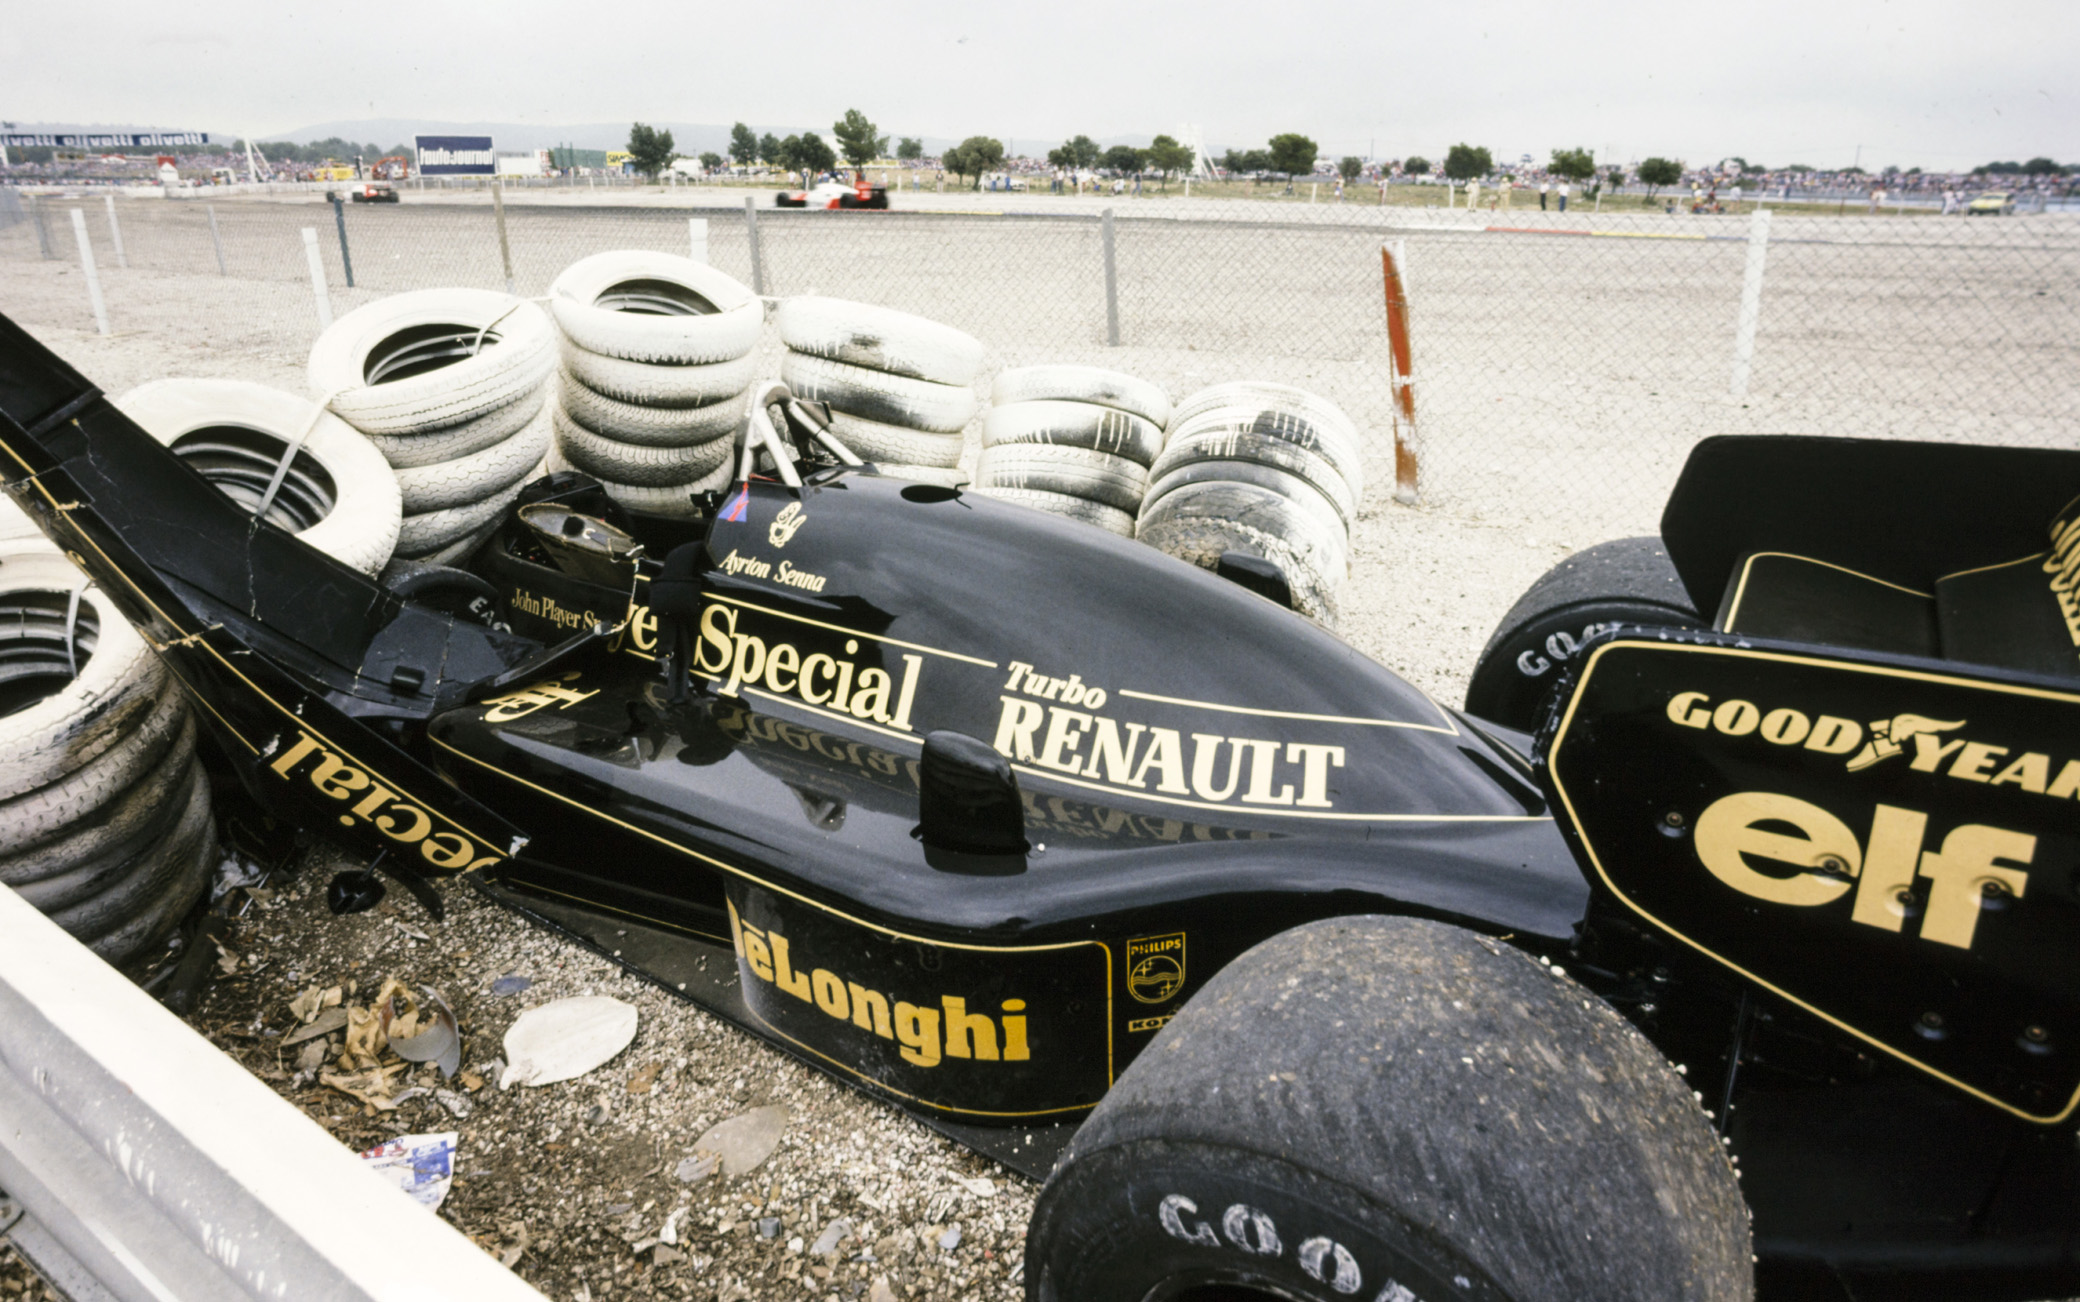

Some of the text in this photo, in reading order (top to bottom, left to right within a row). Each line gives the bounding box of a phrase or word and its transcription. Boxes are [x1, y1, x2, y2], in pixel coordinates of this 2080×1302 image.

[62, 134, 134, 146] olivetti
[140, 133, 203, 146] olivetti
[719, 548, 827, 592] Ayrton Senna
[512, 588, 540, 617] John
[541, 596, 581, 629] Player
[693, 604, 923, 732] Special
[1004, 660, 1107, 710] Turbo
[993, 695, 1345, 808] RENAULT
[270, 729, 502, 872] ecial
[1694, 791, 2038, 950] elf
[1130, 938, 1182, 956] PHILIPS
